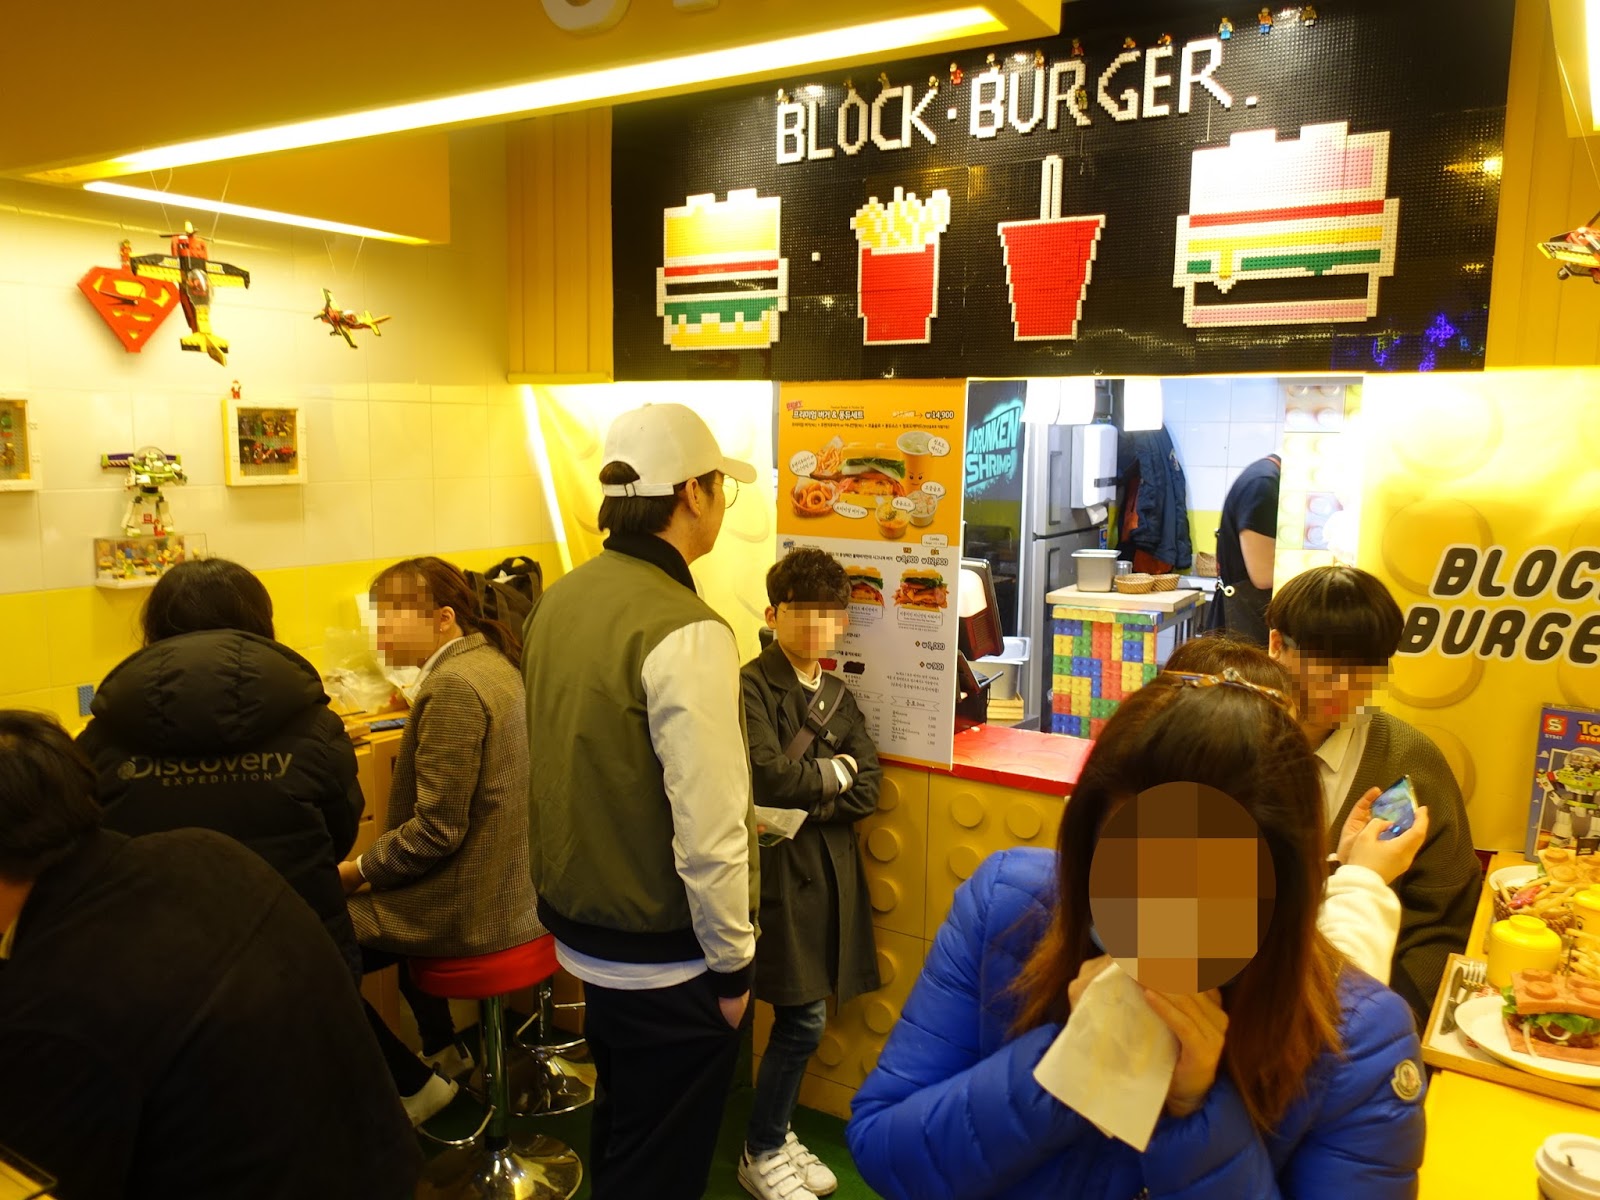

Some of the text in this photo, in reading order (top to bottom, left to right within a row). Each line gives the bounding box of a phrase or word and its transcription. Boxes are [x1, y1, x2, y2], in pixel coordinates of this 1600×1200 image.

[776, 86, 937, 165] BLOCK
[818, 410, 831, 420] 버거
[972, 407, 1021, 453] DRUNKEN
[966, 452, 1012, 484] SHRIMP
[1434, 547, 1600, 601] BLOC
[118, 752, 292, 780] Discovery
[162, 772, 273, 787] EXPEDITION
